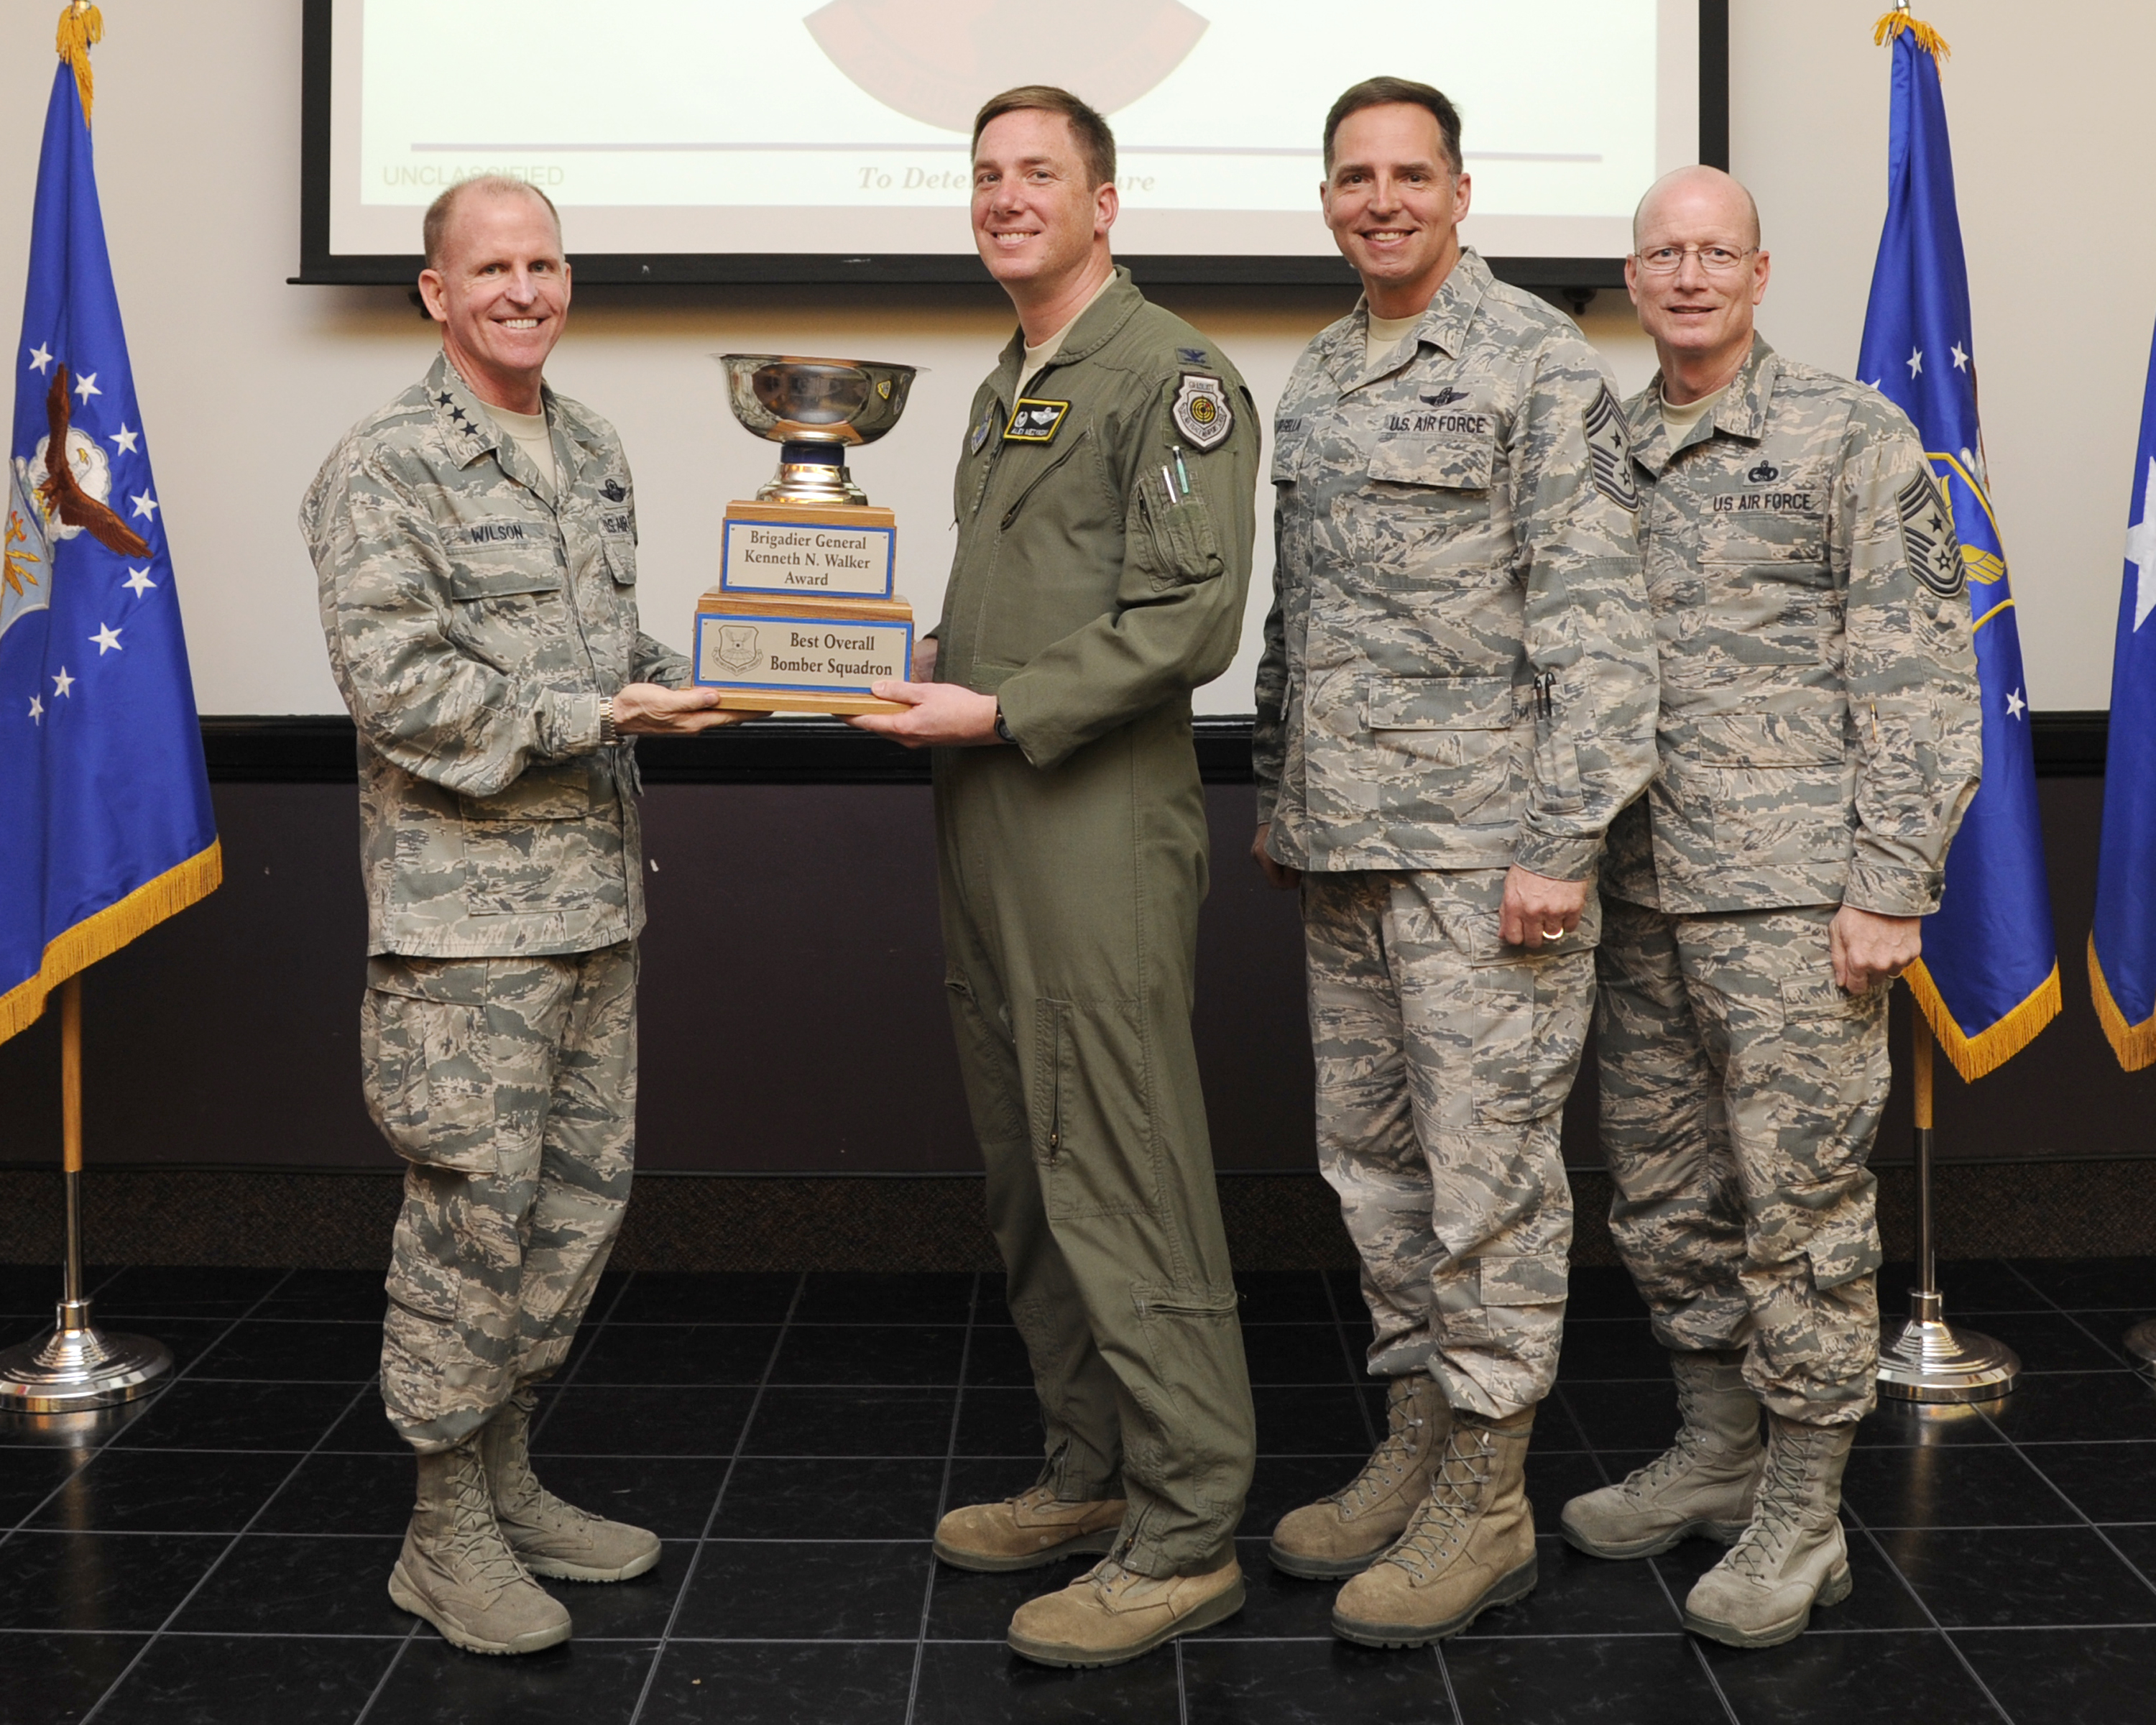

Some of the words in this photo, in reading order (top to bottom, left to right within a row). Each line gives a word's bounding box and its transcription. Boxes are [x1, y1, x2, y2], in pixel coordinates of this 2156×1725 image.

[857, 166, 893, 190] To
[1413, 416, 1437, 431] AIR
[1439, 415, 1486, 433] FORCE
[1738, 494, 1761, 510] AIR
[1764, 493, 1811, 511] FORCE
[471, 524, 523, 543] WILSON
[750, 530, 811, 548] Brigadier
[815, 534, 867, 550] General
[744, 549, 801, 566] Kenneth
[804, 553, 820, 566] N.
[824, 553, 871, 569] Walker
[784, 571, 829, 586] Award
[790, 632, 819, 648] Best
[824, 633, 875, 650] Overall
[770, 656, 824, 673] Bomber
[826, 658, 893, 678] Squadron
